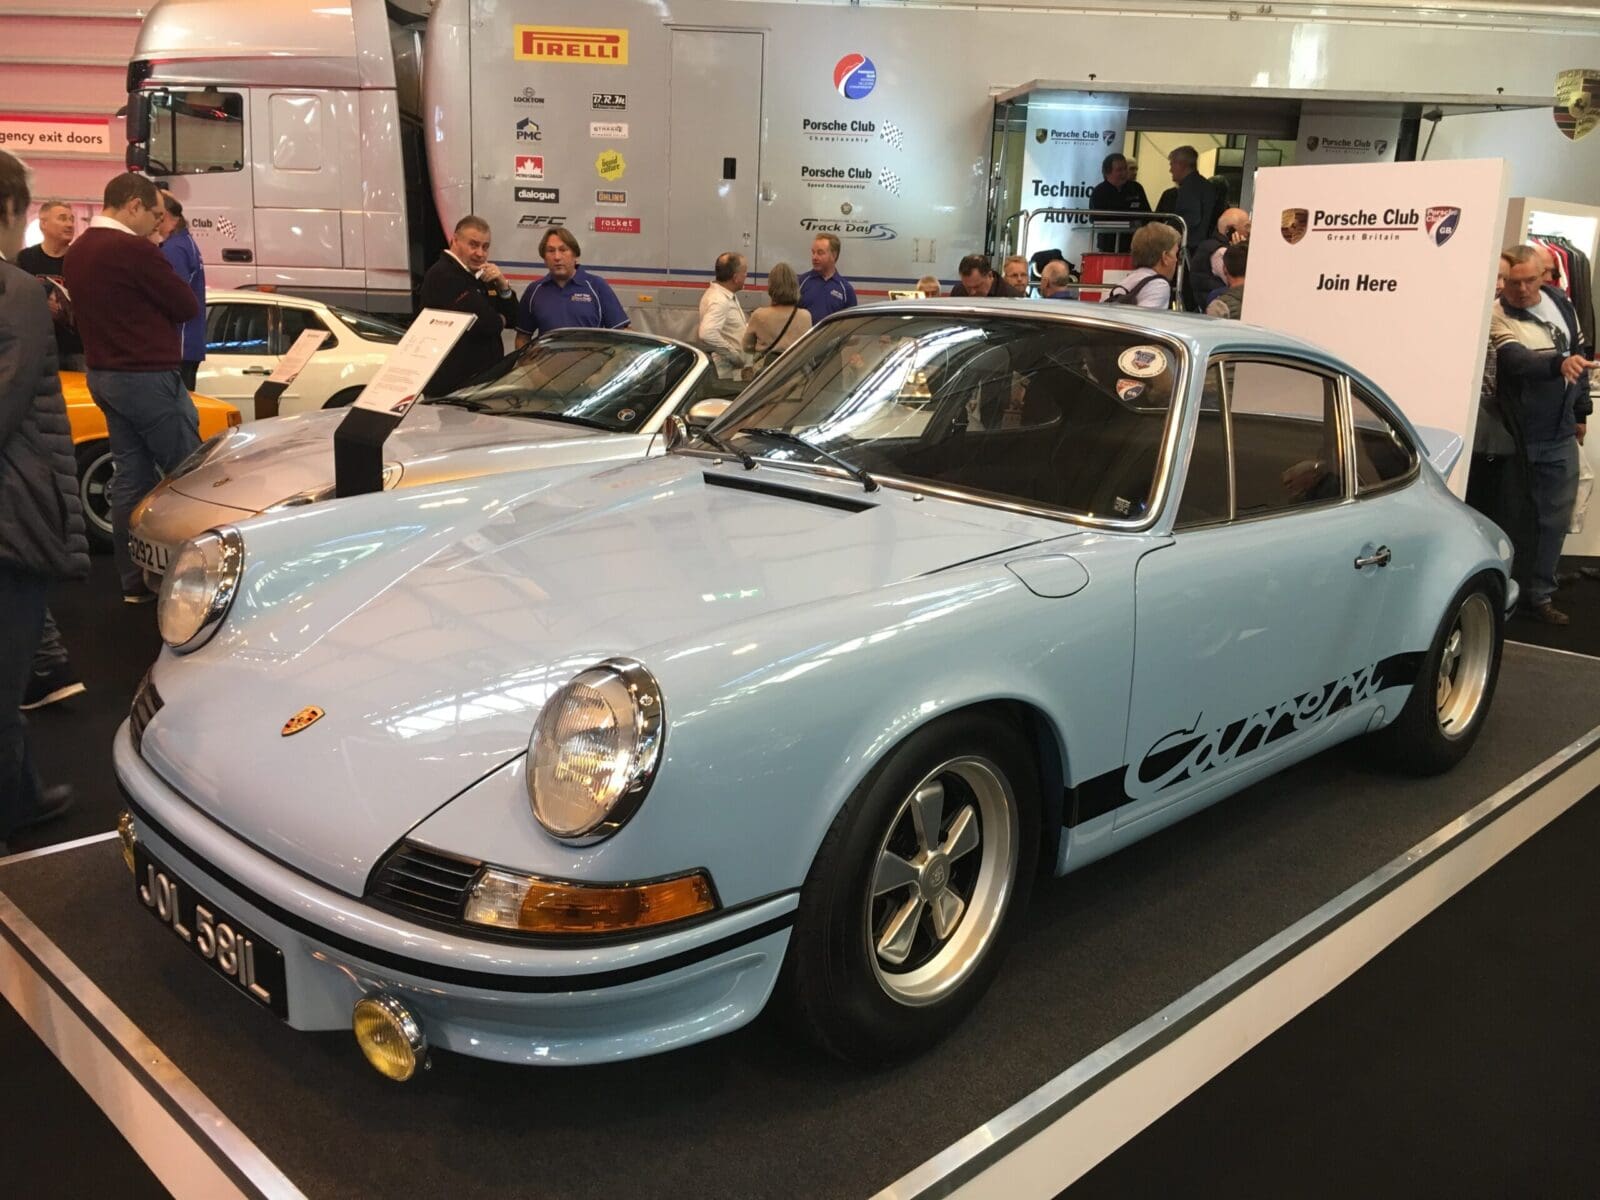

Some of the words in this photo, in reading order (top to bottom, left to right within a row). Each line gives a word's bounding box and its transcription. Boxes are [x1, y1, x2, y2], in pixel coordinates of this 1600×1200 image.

[522, 31, 620, 58] PIRELLI
[803, 119, 847, 131] Porsche
[850, 120, 876, 132] Club
[38, 131, 62, 142] exit
[66, 131, 103, 144] doors
[516, 131, 542, 141] PMC
[1051, 129, 1080, 138] Porsche
[1082, 130, 1099, 138] Club
[802, 166, 844, 178] Porsche
[848, 168, 872, 179] Club
[518, 190, 556, 200] dialogue
[519, 215, 566, 226] PFC
[1044, 206, 1095, 224] Advic
[1314, 210, 1377, 226] Porsche
[1383, 208, 1420, 225] Club
[192, 218, 213, 228] Club
[800, 218, 841, 232] Track
[1316, 273, 1350, 291] Join
[1356, 274, 1397, 292] Here
[1123, 664, 1384, 801] Carrera
[140, 864, 192, 942] JOL
[196, 904, 271, 1004] 581L
